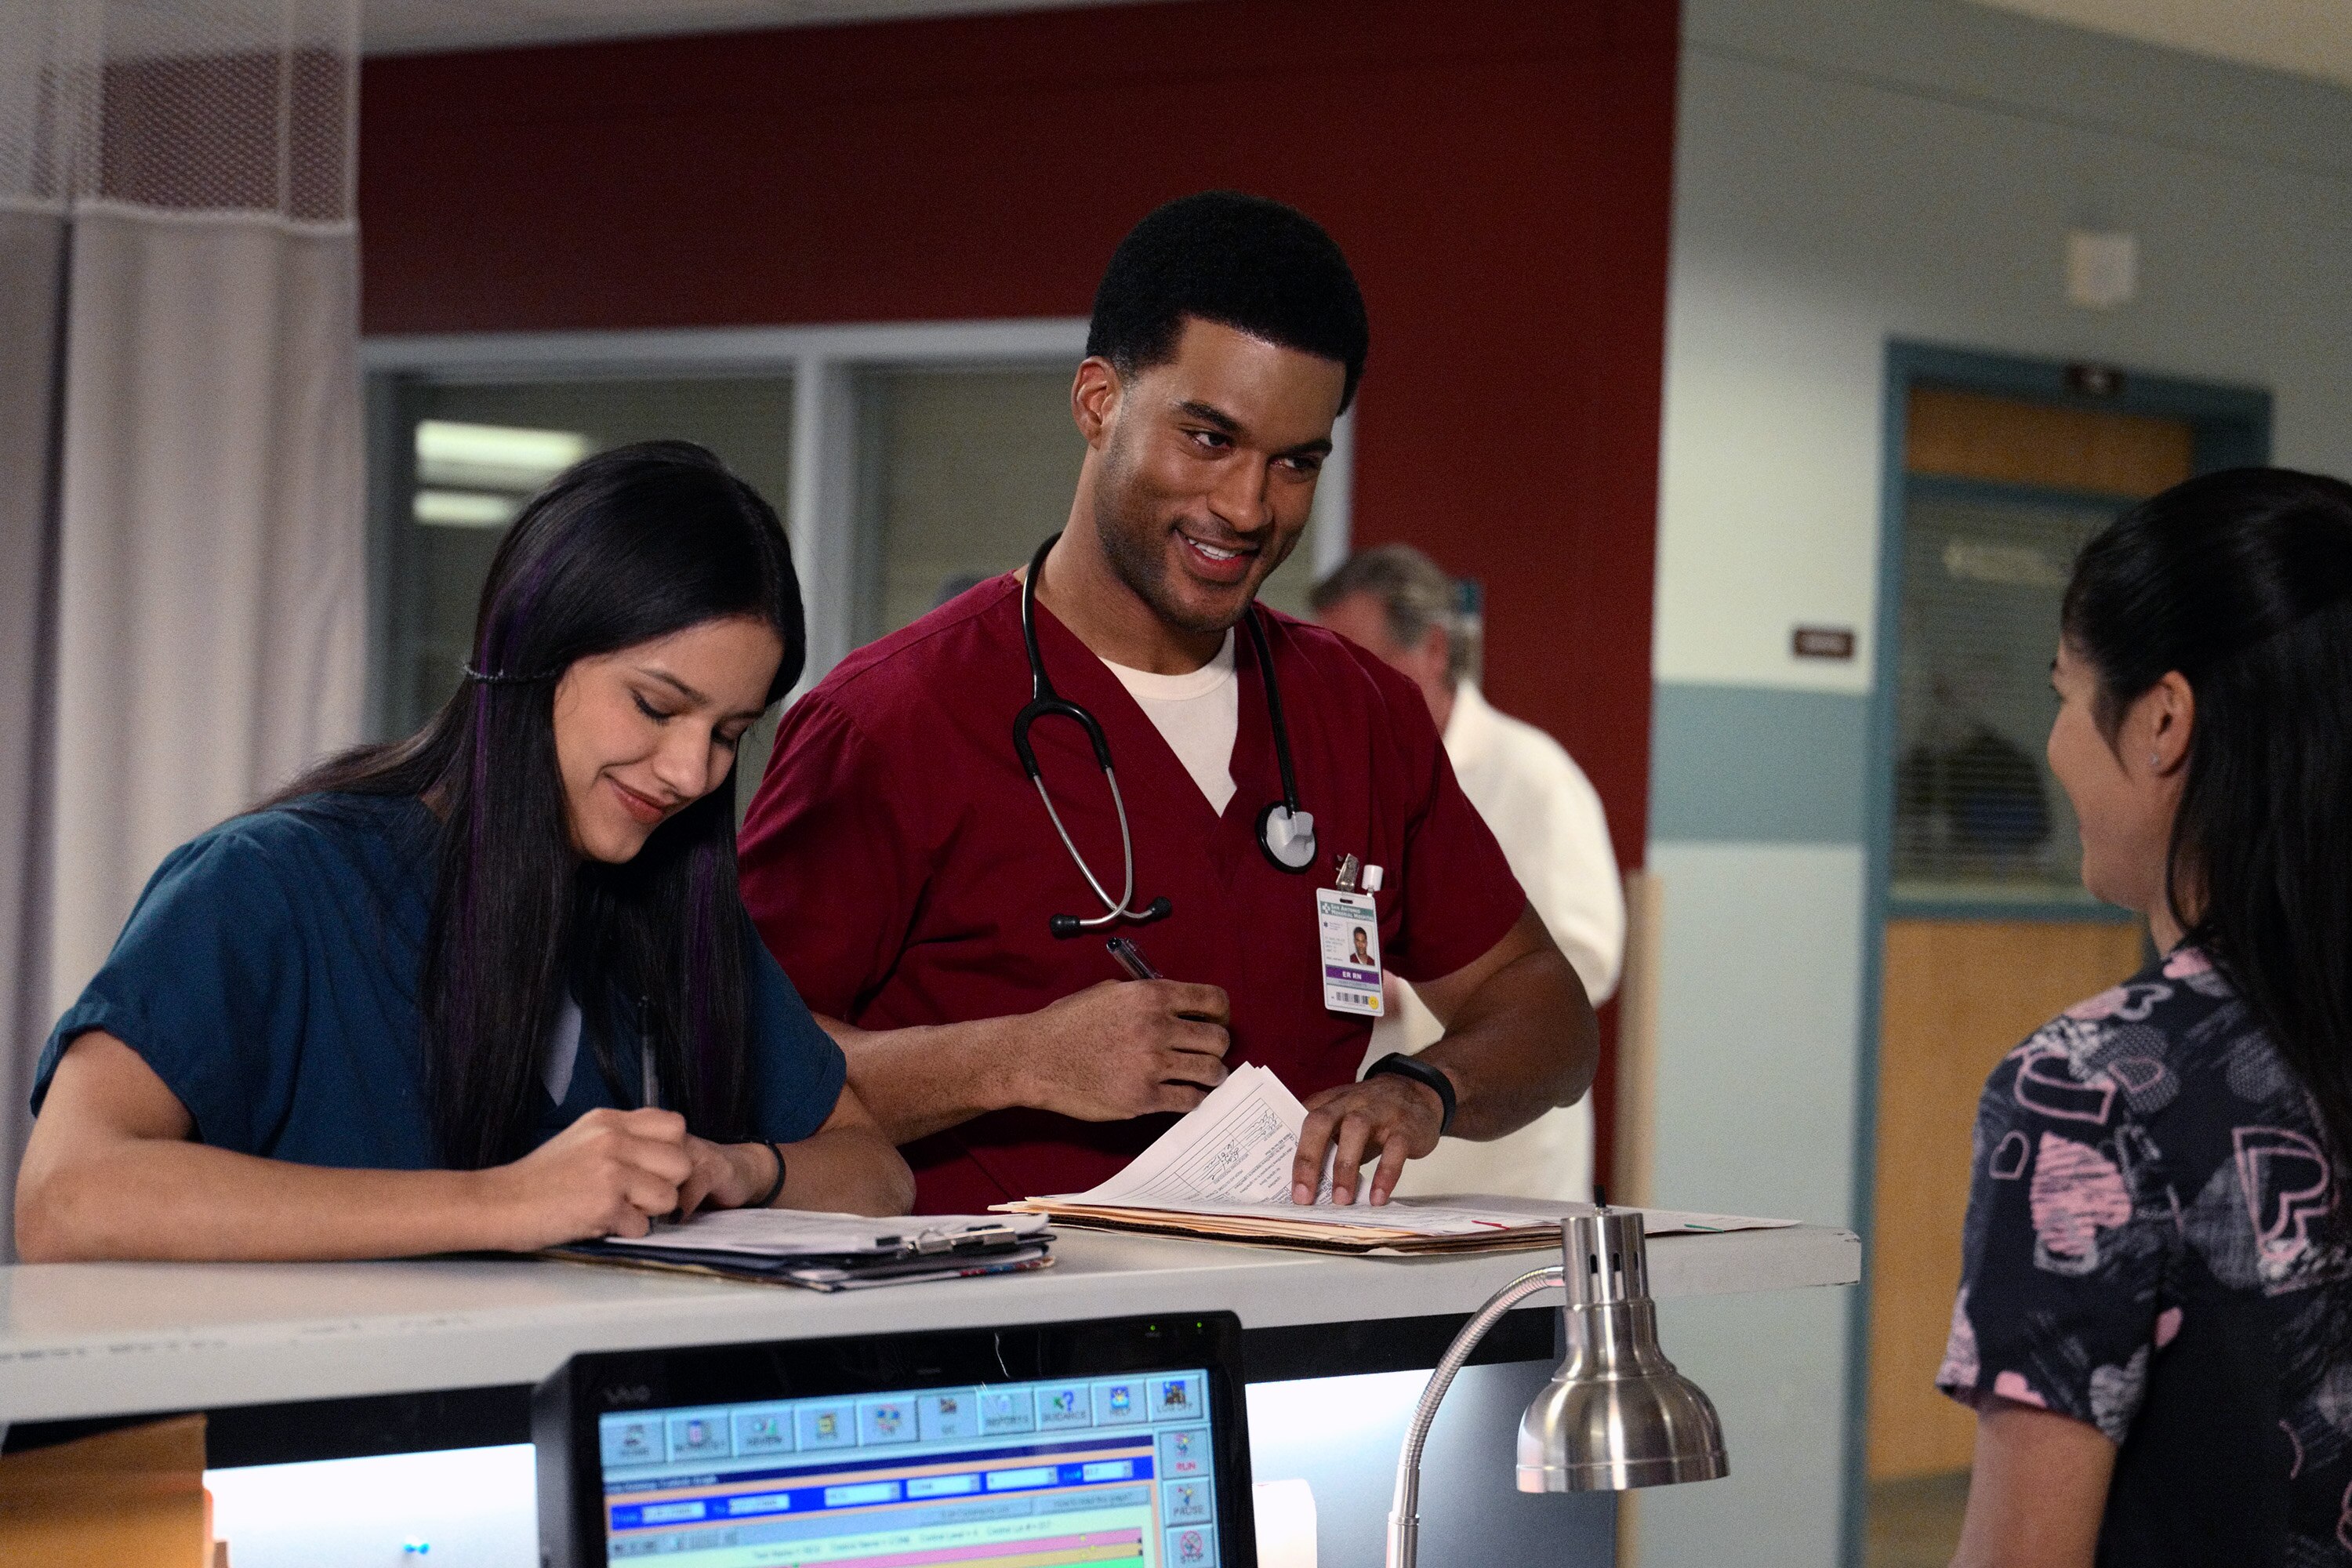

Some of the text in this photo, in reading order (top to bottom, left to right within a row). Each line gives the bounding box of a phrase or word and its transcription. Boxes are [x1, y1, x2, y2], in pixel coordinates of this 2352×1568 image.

[1340, 906, 1361, 914] ANTONIO
[1353, 913, 1374, 921] HOSPITAL
[1176, 1461, 1196, 1472] RUN
[1174, 1504, 1203, 1516] PAUSE
